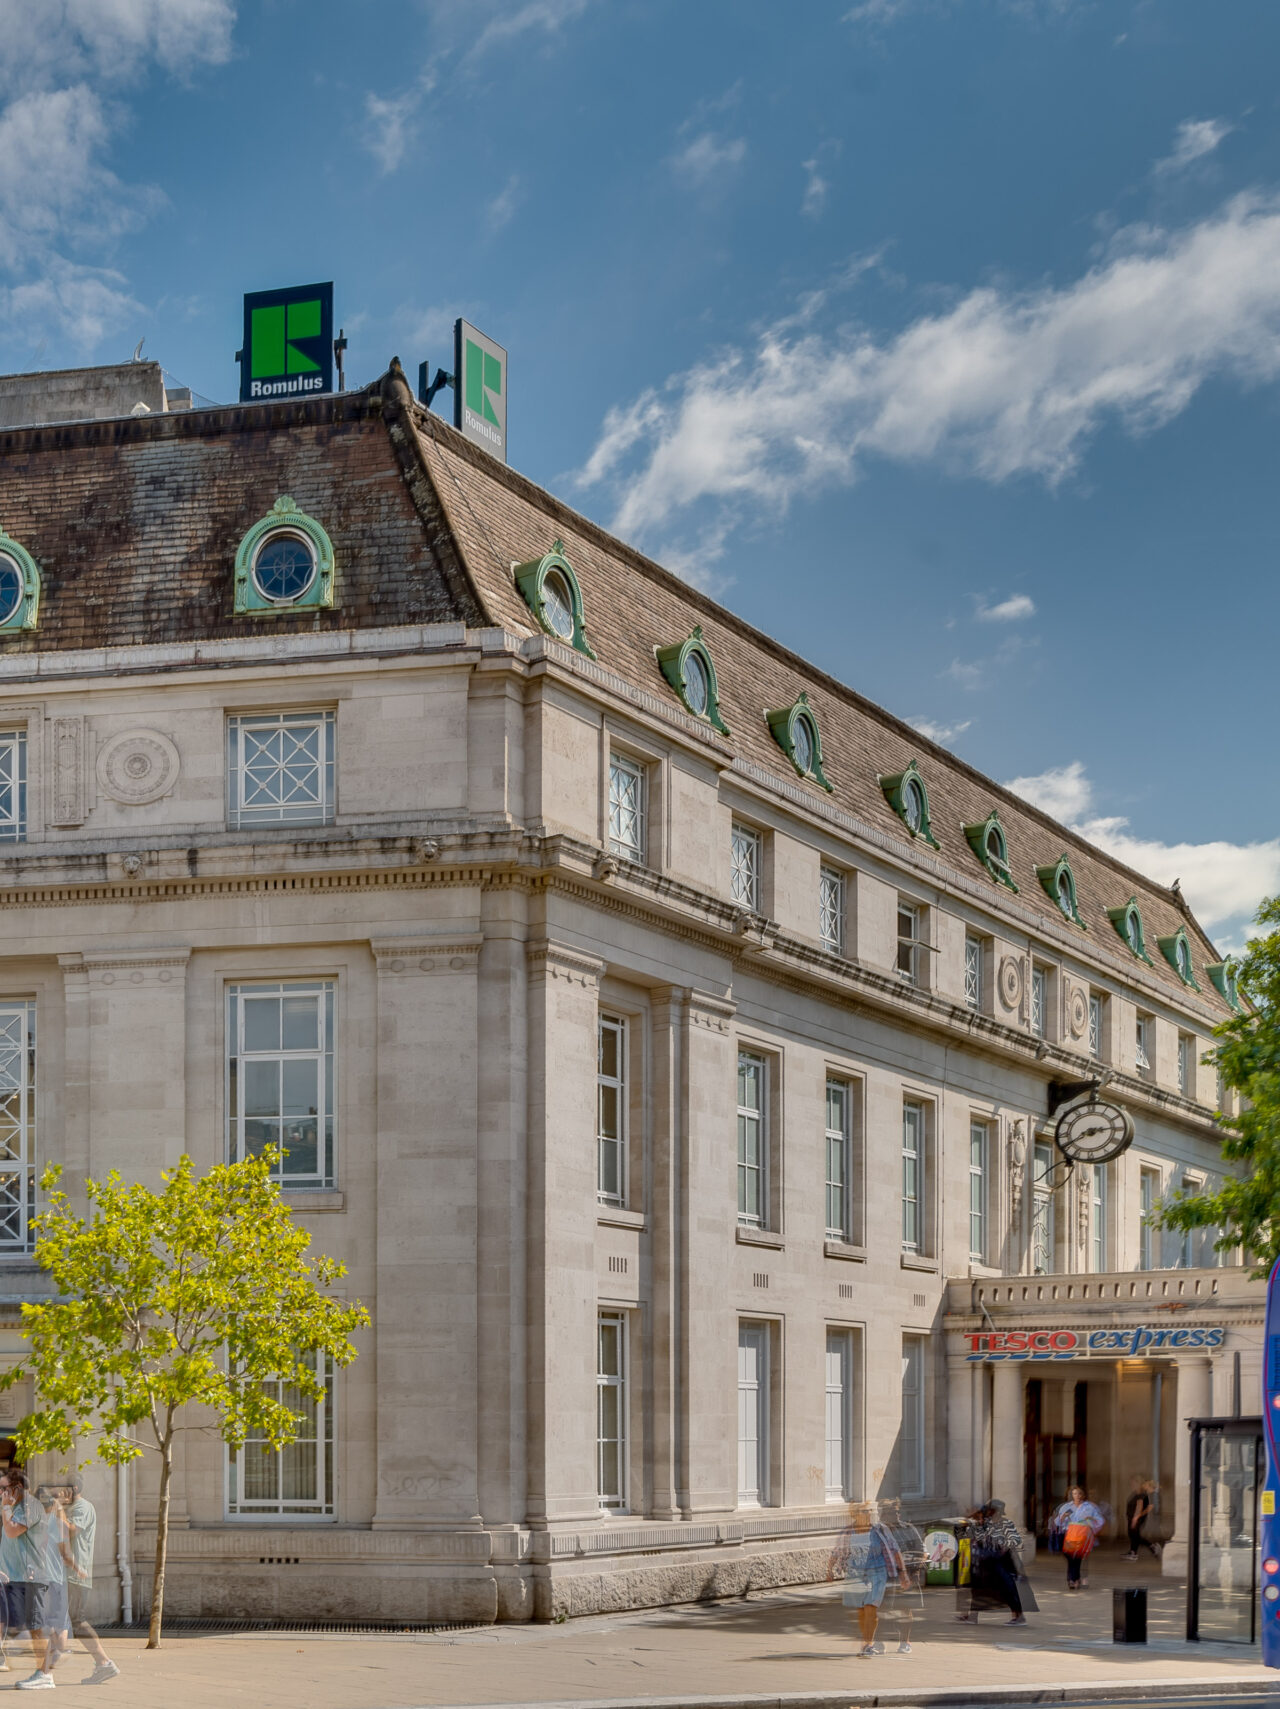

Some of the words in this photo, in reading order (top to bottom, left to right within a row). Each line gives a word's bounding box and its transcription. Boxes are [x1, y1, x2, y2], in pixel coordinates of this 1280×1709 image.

[251, 376, 323, 397] Romulus
[465, 409, 502, 448] Romulus
[964, 1330, 1077, 1352] TESCO
[1088, 1326, 1223, 1355] express
